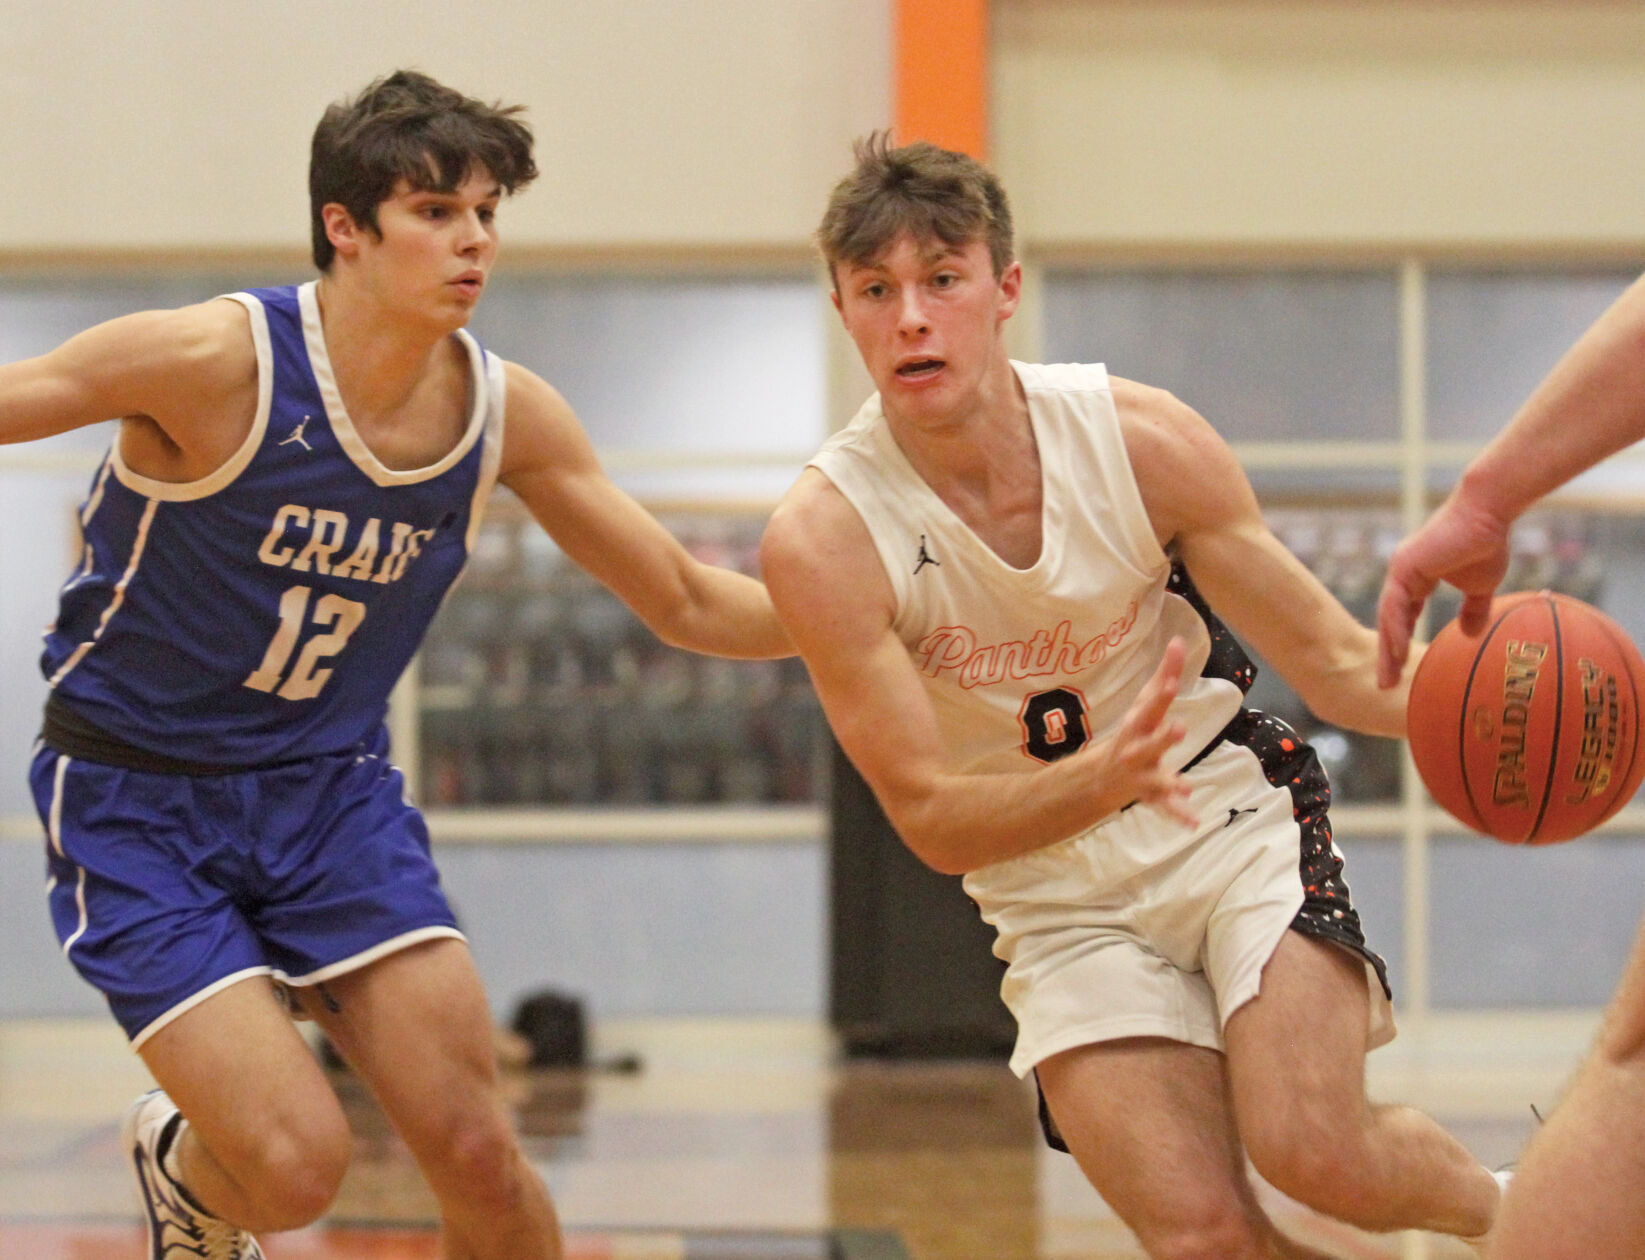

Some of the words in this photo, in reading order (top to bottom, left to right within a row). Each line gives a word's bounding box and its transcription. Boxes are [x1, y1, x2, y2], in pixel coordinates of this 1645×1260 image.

[242, 585, 367, 701] 12
[1016, 685, 1092, 767] 0
[1492, 639, 1548, 810] SPALDING
[1564, 657, 1604, 805] LEGACY
